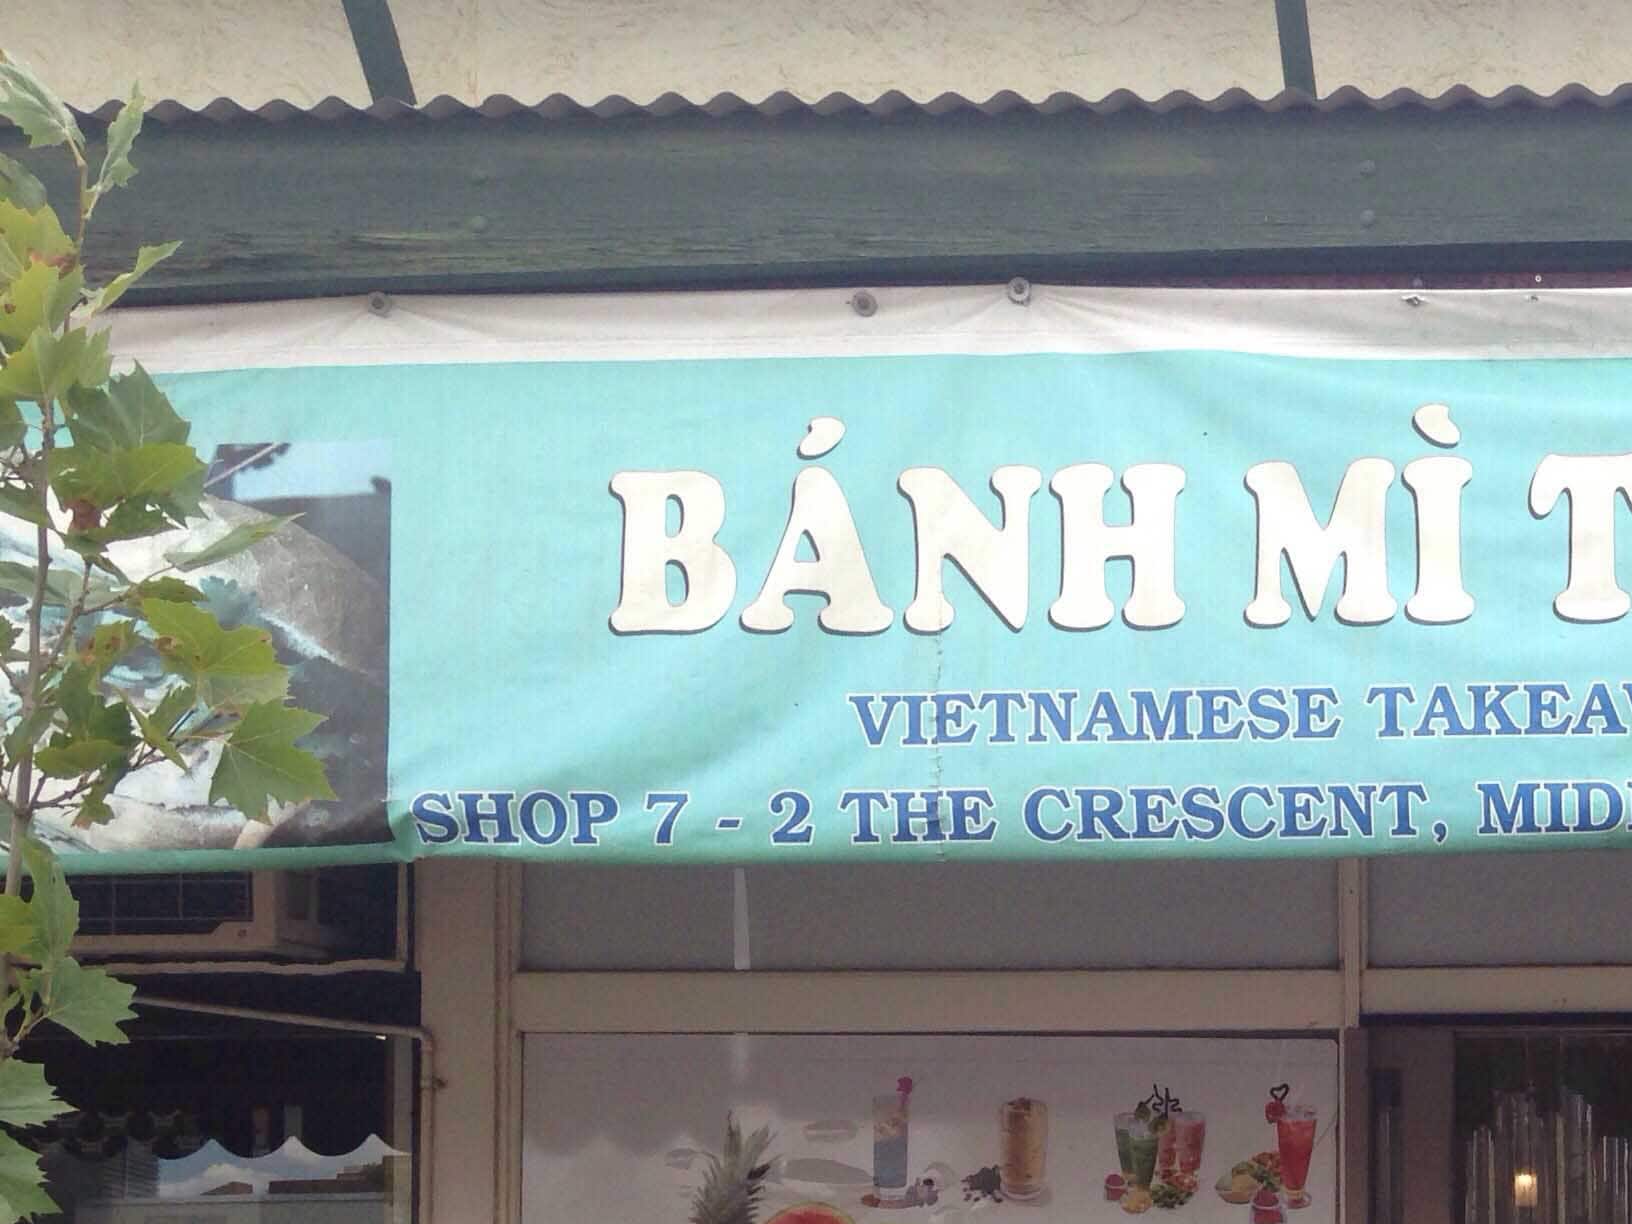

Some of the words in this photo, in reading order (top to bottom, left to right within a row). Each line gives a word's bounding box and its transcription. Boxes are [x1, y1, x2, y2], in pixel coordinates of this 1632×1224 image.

[608, 416, 1187, 635] BÁNH
[1244, 403, 1476, 629] MÌ
[848, 682, 1344, 748] VIETNAMESE
[409, 789, 619, 847] SHOP
[645, 791, 690, 846] 7
[770, 789, 815, 844] 2
[839, 787, 1000, 844] THE
[1022, 782, 1450, 845] CRESCENT,
